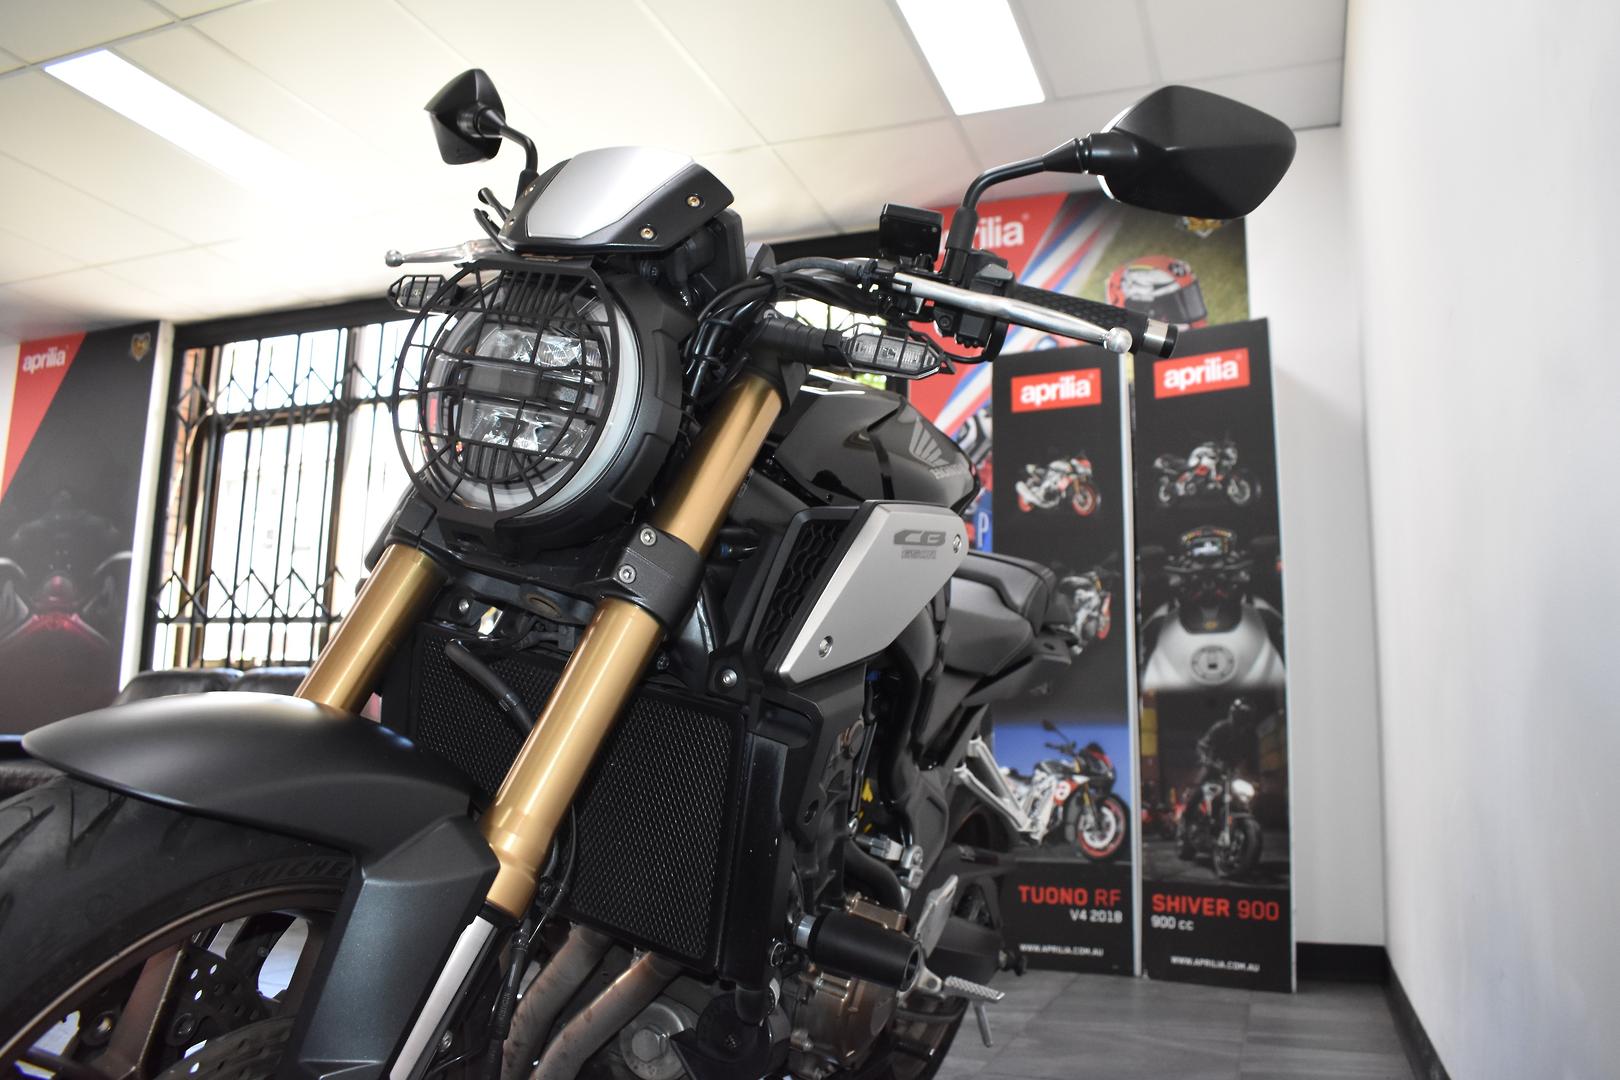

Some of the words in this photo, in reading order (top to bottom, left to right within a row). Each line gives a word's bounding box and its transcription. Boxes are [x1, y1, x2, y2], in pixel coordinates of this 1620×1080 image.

[23, 346, 66, 374] aprilia
[1163, 356, 1239, 392] aprilia
[1020, 375, 1091, 408] aprilia
[894, 529, 947, 547] CB
[1018, 884, 1089, 907] TUONO
[1094, 888, 1121, 907] RF
[1070, 908, 1088, 922] V4
[1089, 909, 1123, 924] 2018
[1152, 894, 1230, 918] SHIVER
[1237, 900, 1280, 921] 900
[1150, 914, 1177, 930] 900
[1178, 919, 1195, 931] cc
[1019, 943, 1105, 957] WWW.APRILIA.COM.AU
[1170, 955, 1261, 973] WWW.APRILIA.COM.AU
